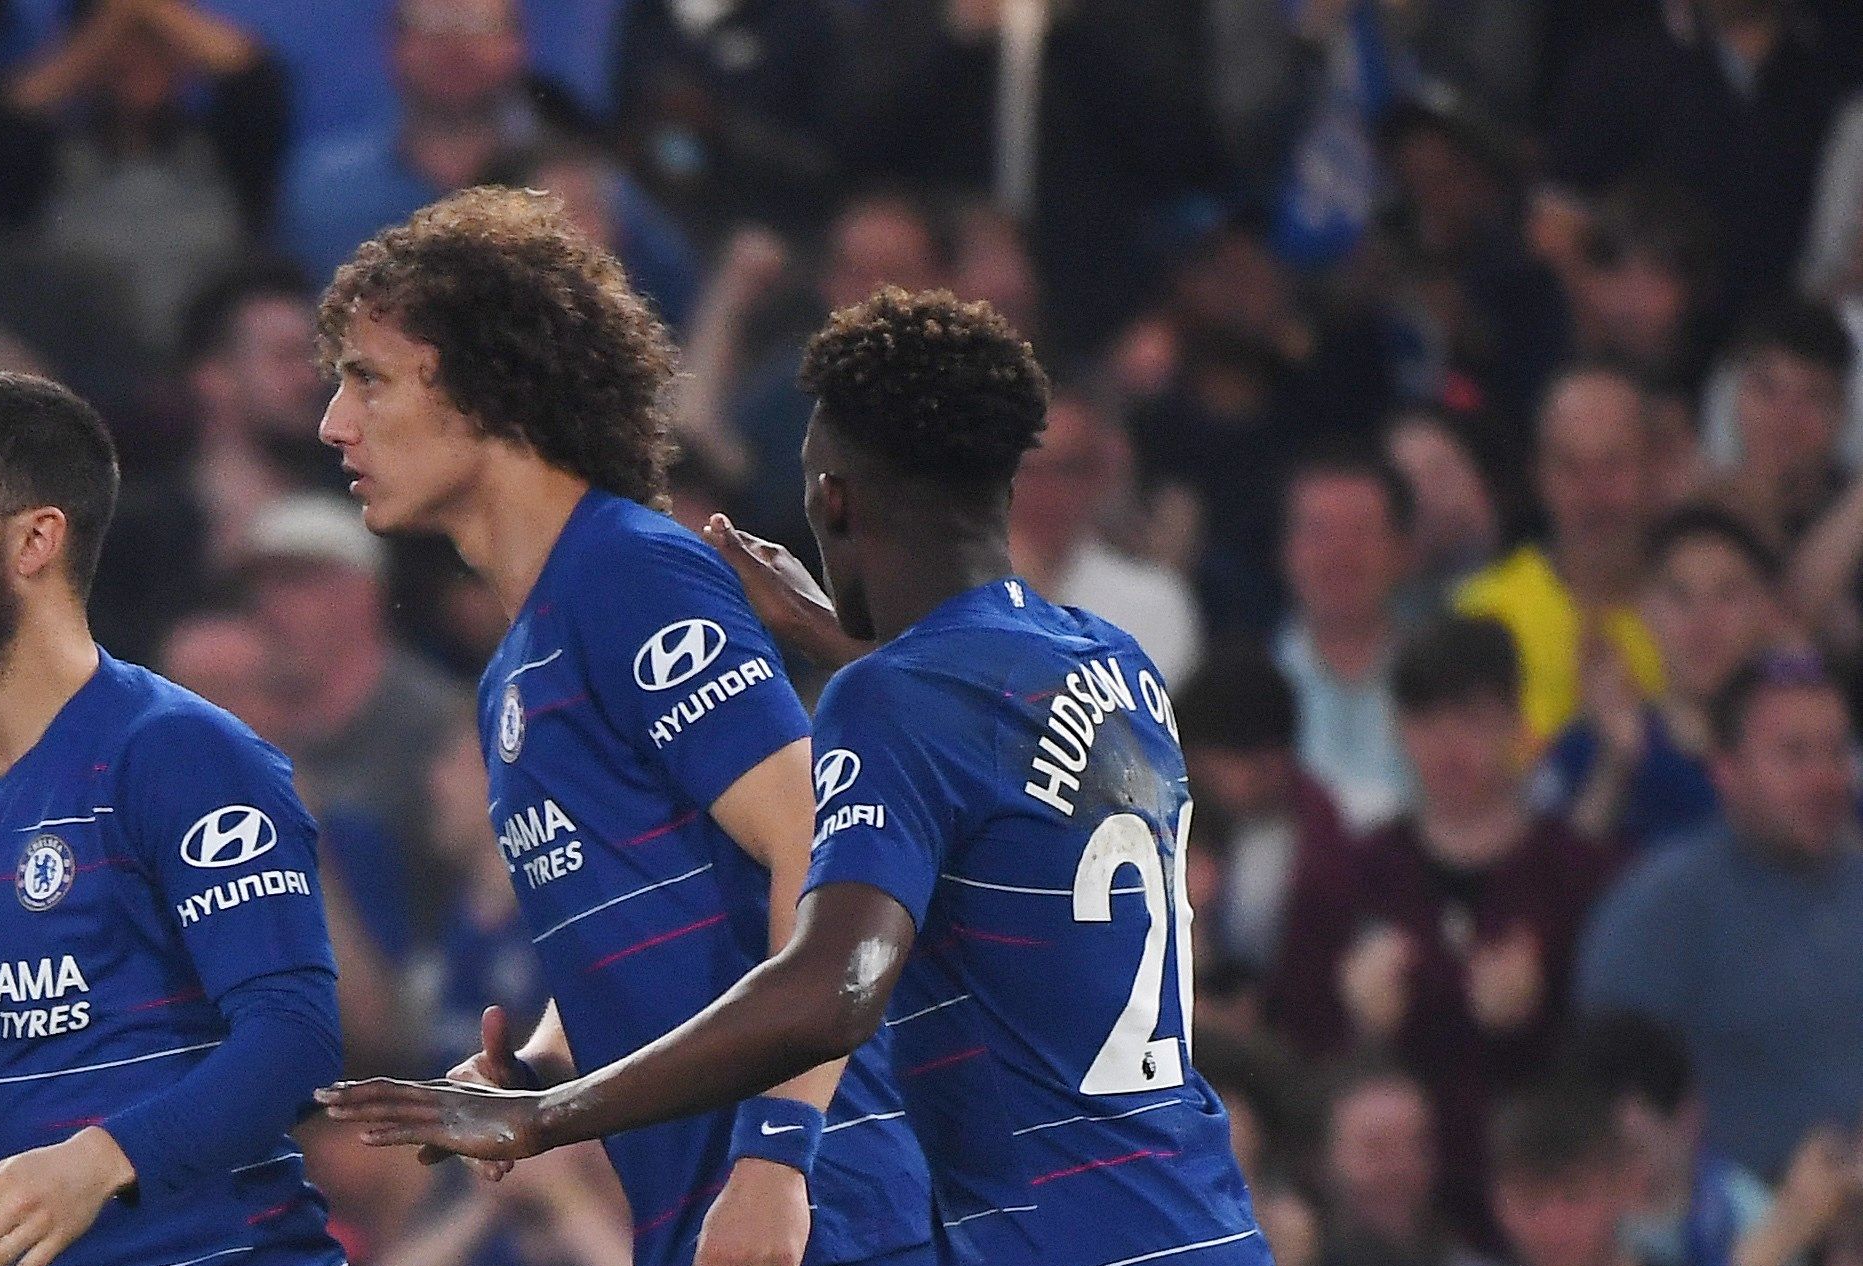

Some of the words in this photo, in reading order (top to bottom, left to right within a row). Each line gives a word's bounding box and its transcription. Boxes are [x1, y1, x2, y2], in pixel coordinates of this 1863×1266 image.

[648, 657, 774, 749] HYUNDAI
[1024, 657, 1137, 816] HUDSON
[177, 870, 311, 928] HYUNDAI
[523, 840, 584, 890] TYRES
[1073, 799, 1194, 1095] 2
[0, 1001, 91, 1039] TYRES
